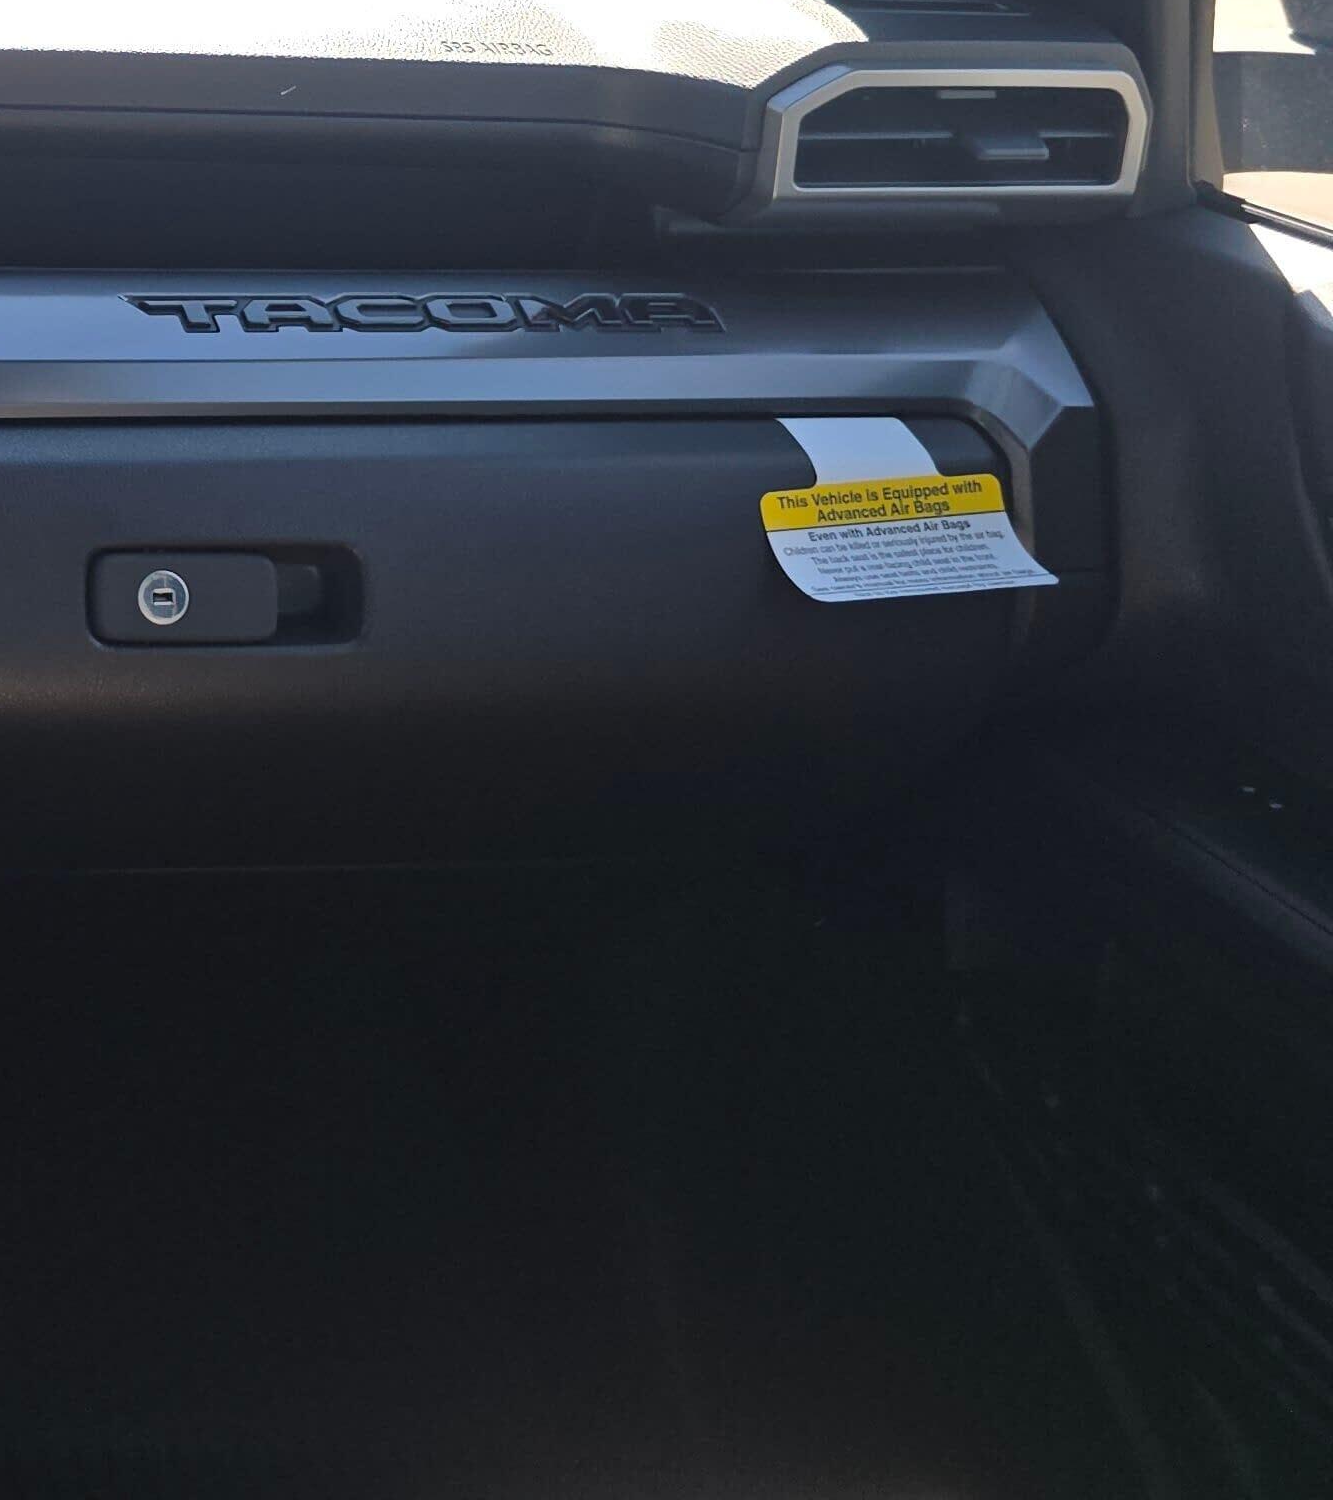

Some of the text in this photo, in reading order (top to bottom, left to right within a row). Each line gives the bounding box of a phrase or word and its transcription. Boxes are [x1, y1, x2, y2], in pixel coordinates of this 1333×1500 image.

[117, 292, 727, 334] TACOMA
[777, 480, 983, 510] This Vehicle is Equipped with
[817, 498, 950, 523] Advanced Air Bags
[807, 519, 971, 542] Even with Advanced Air Bags
